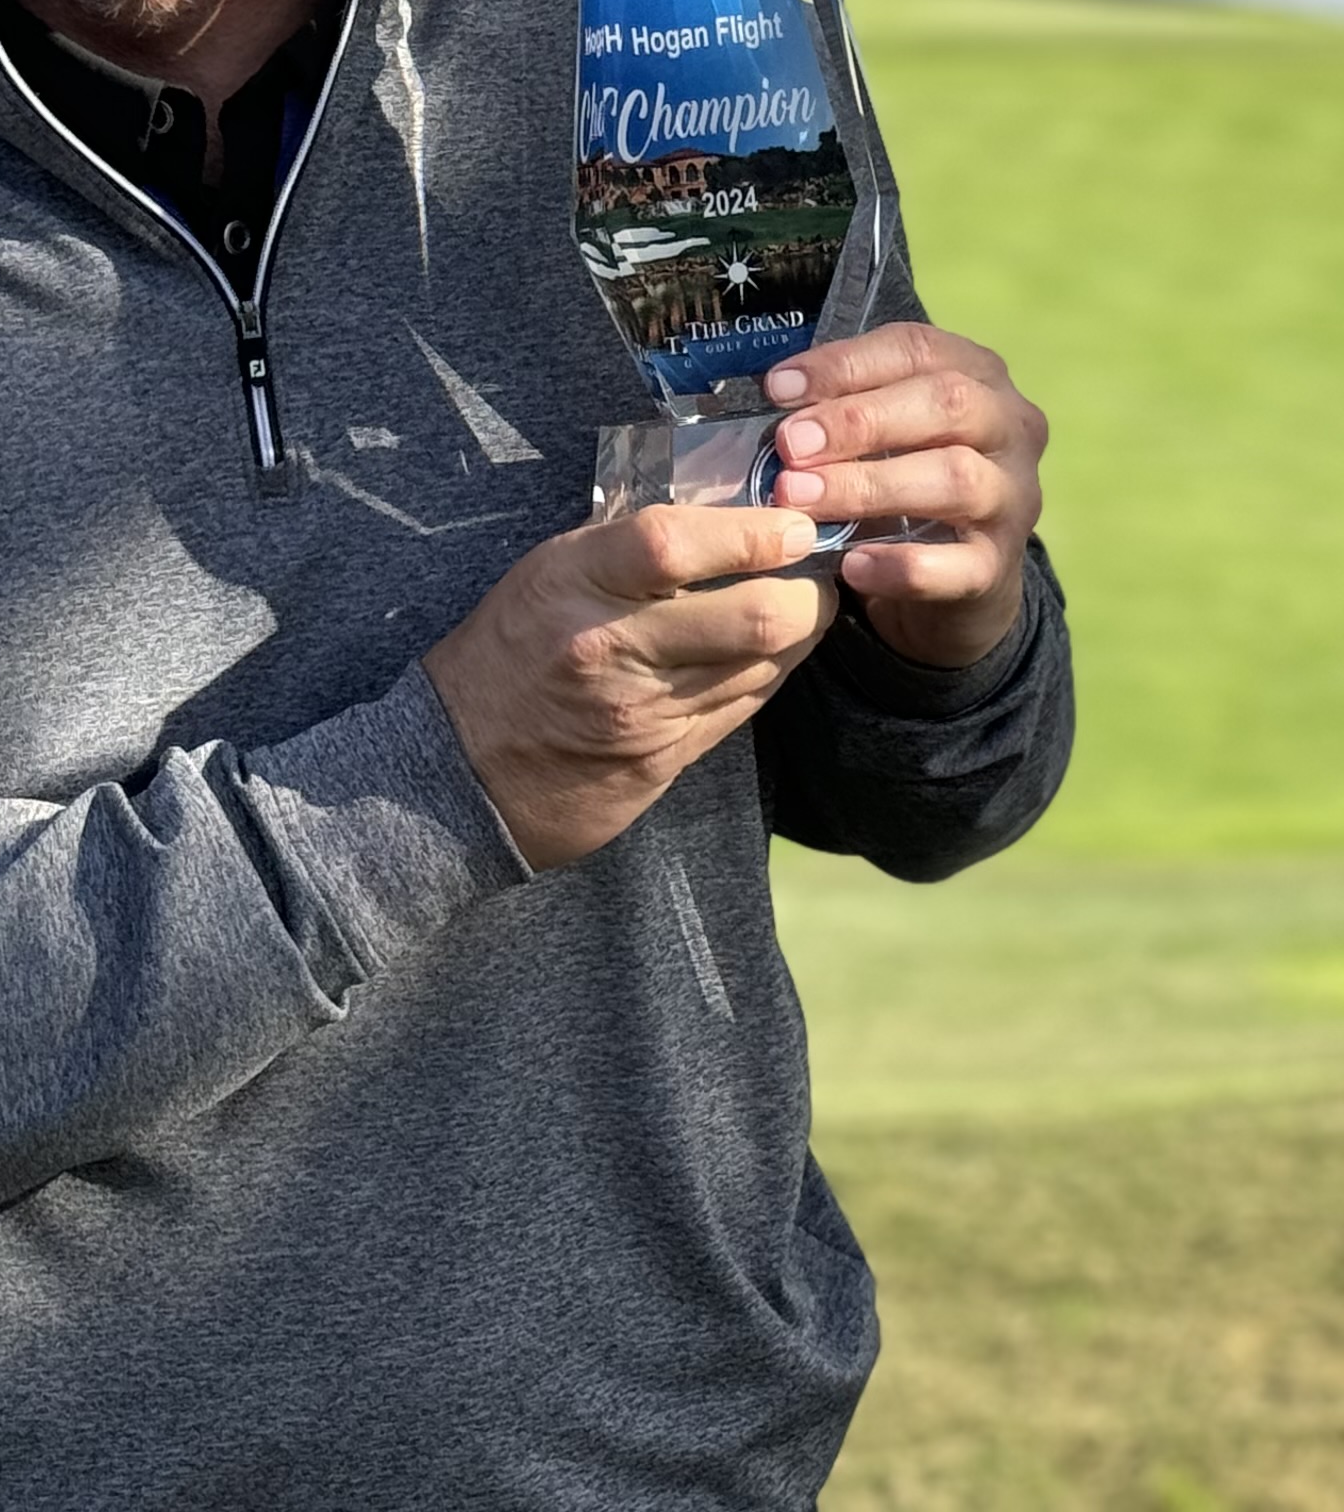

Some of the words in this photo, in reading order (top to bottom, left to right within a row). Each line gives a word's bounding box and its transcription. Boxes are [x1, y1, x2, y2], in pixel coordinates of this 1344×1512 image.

[631, 24, 709, 59] Hogan
[715, 10, 784, 49] Flight
[617, 76, 817, 164] Champion
[701, 185, 759, 219] 2024
[685, 320, 731, 341] THE
[735, 310, 805, 336] GRAND
